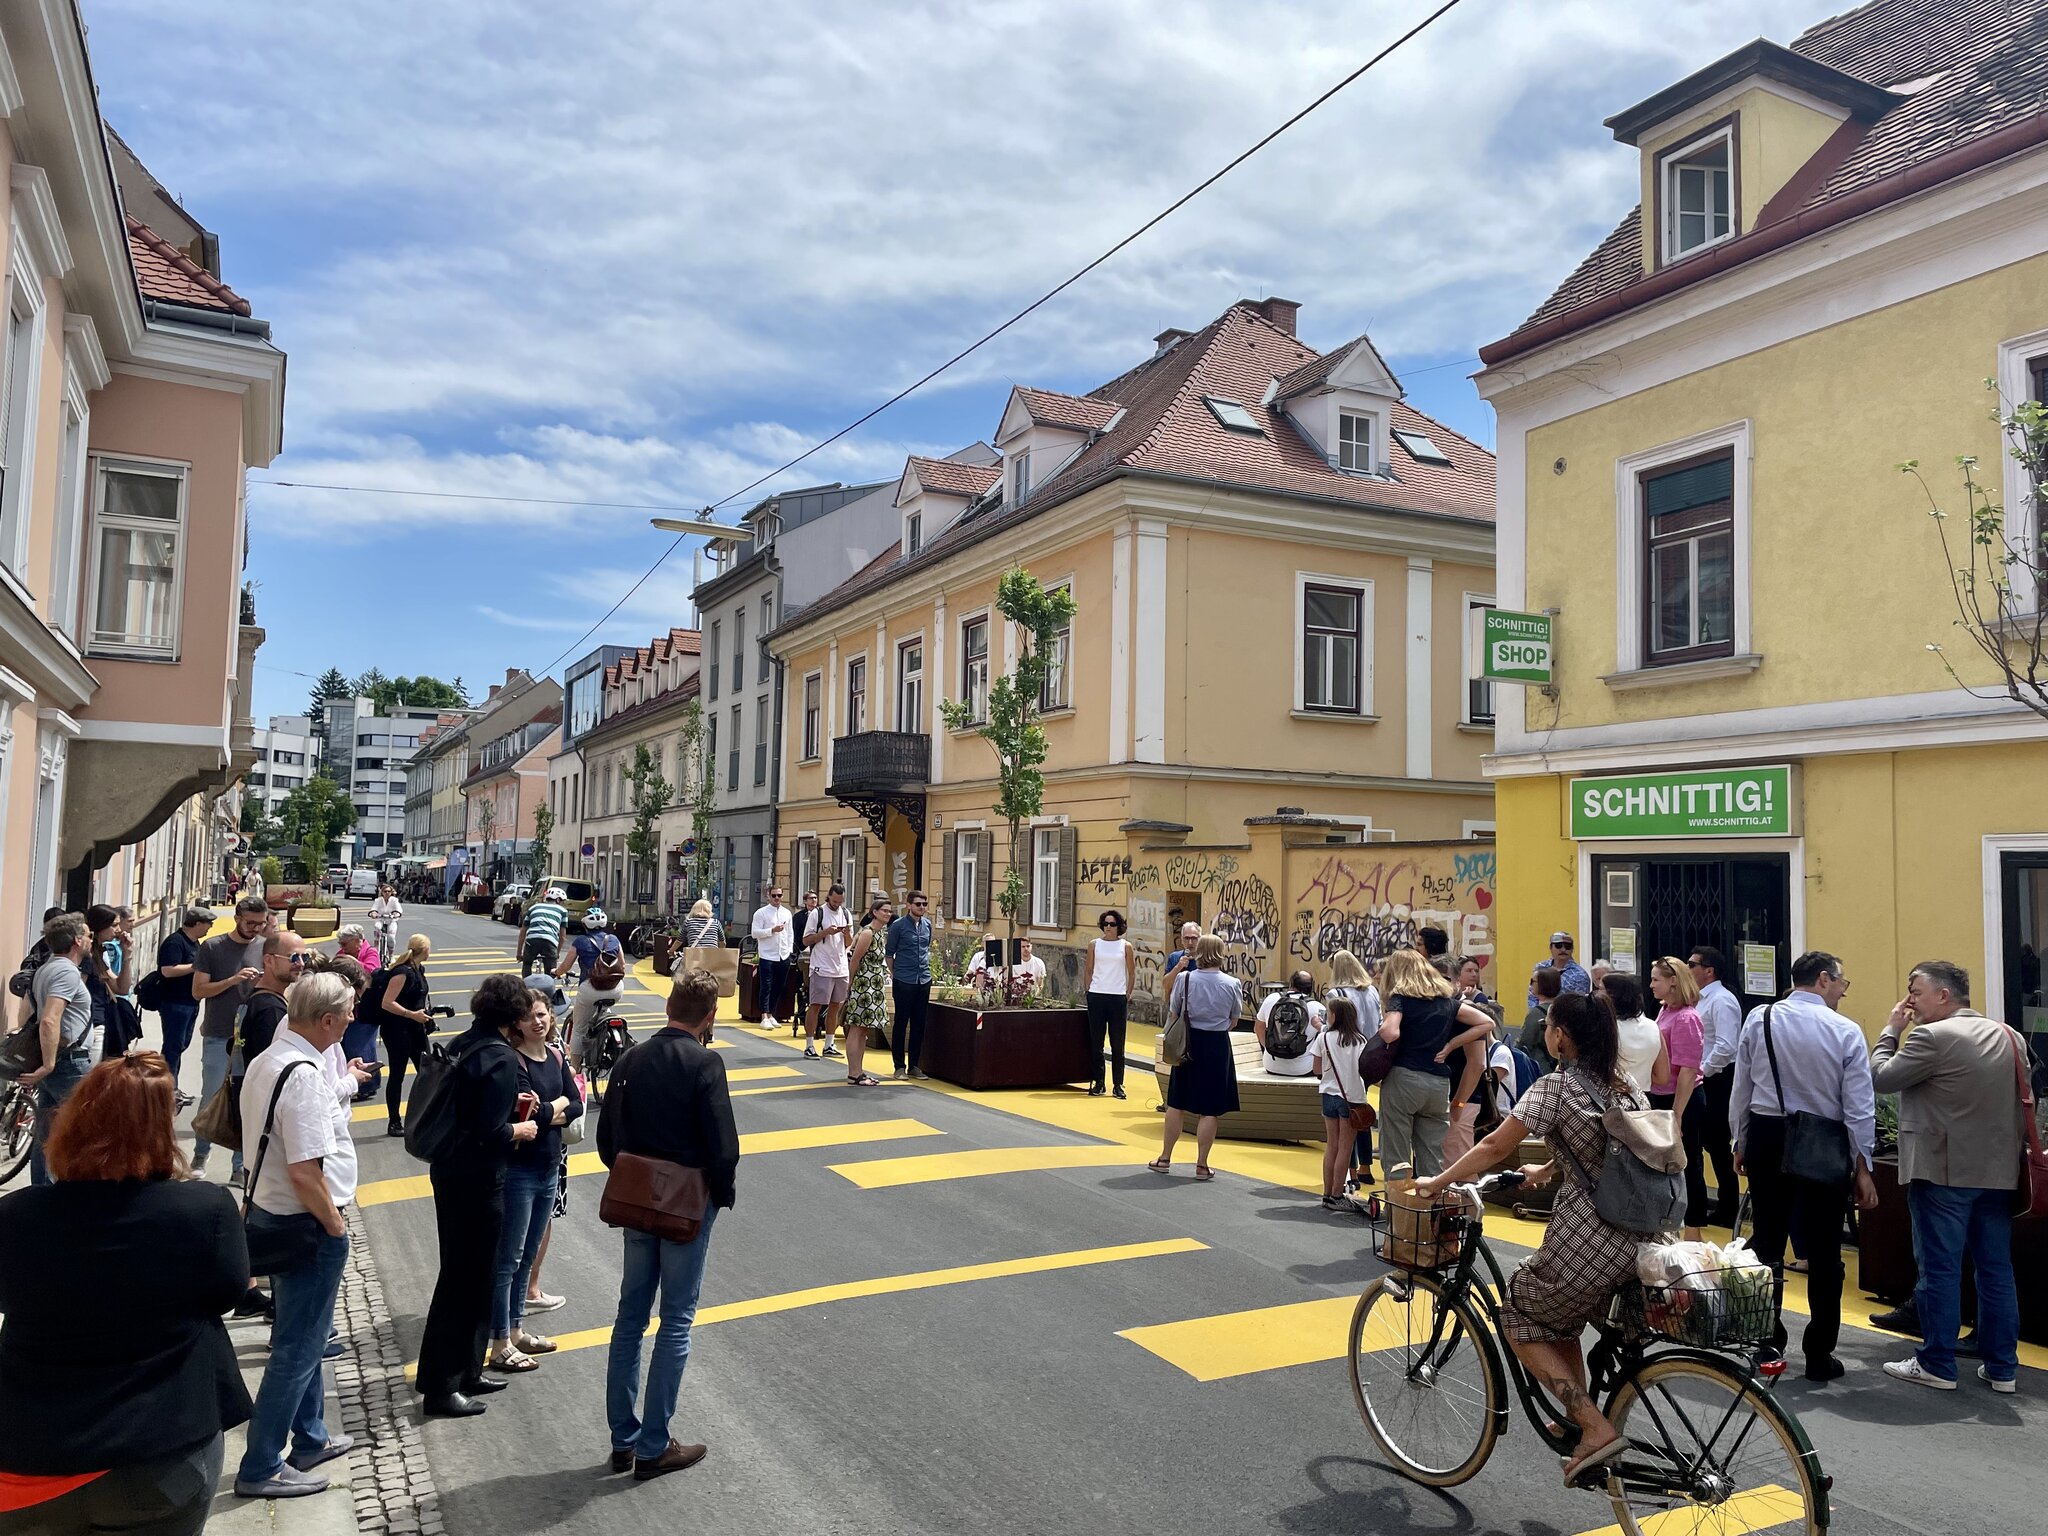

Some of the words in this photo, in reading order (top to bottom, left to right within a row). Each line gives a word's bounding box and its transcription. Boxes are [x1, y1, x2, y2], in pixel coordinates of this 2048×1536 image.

[1488, 617, 1548, 634] SCHNITTIG!
[1498, 644, 1547, 665] SHOP
[1584, 780, 1773, 818] SCHNITTIG!
[1688, 816, 1773, 827] WWW.SCHNITTIG.AT
[1080, 856, 1132, 884] AFTER
[1241, 952, 1266, 978] ROT
